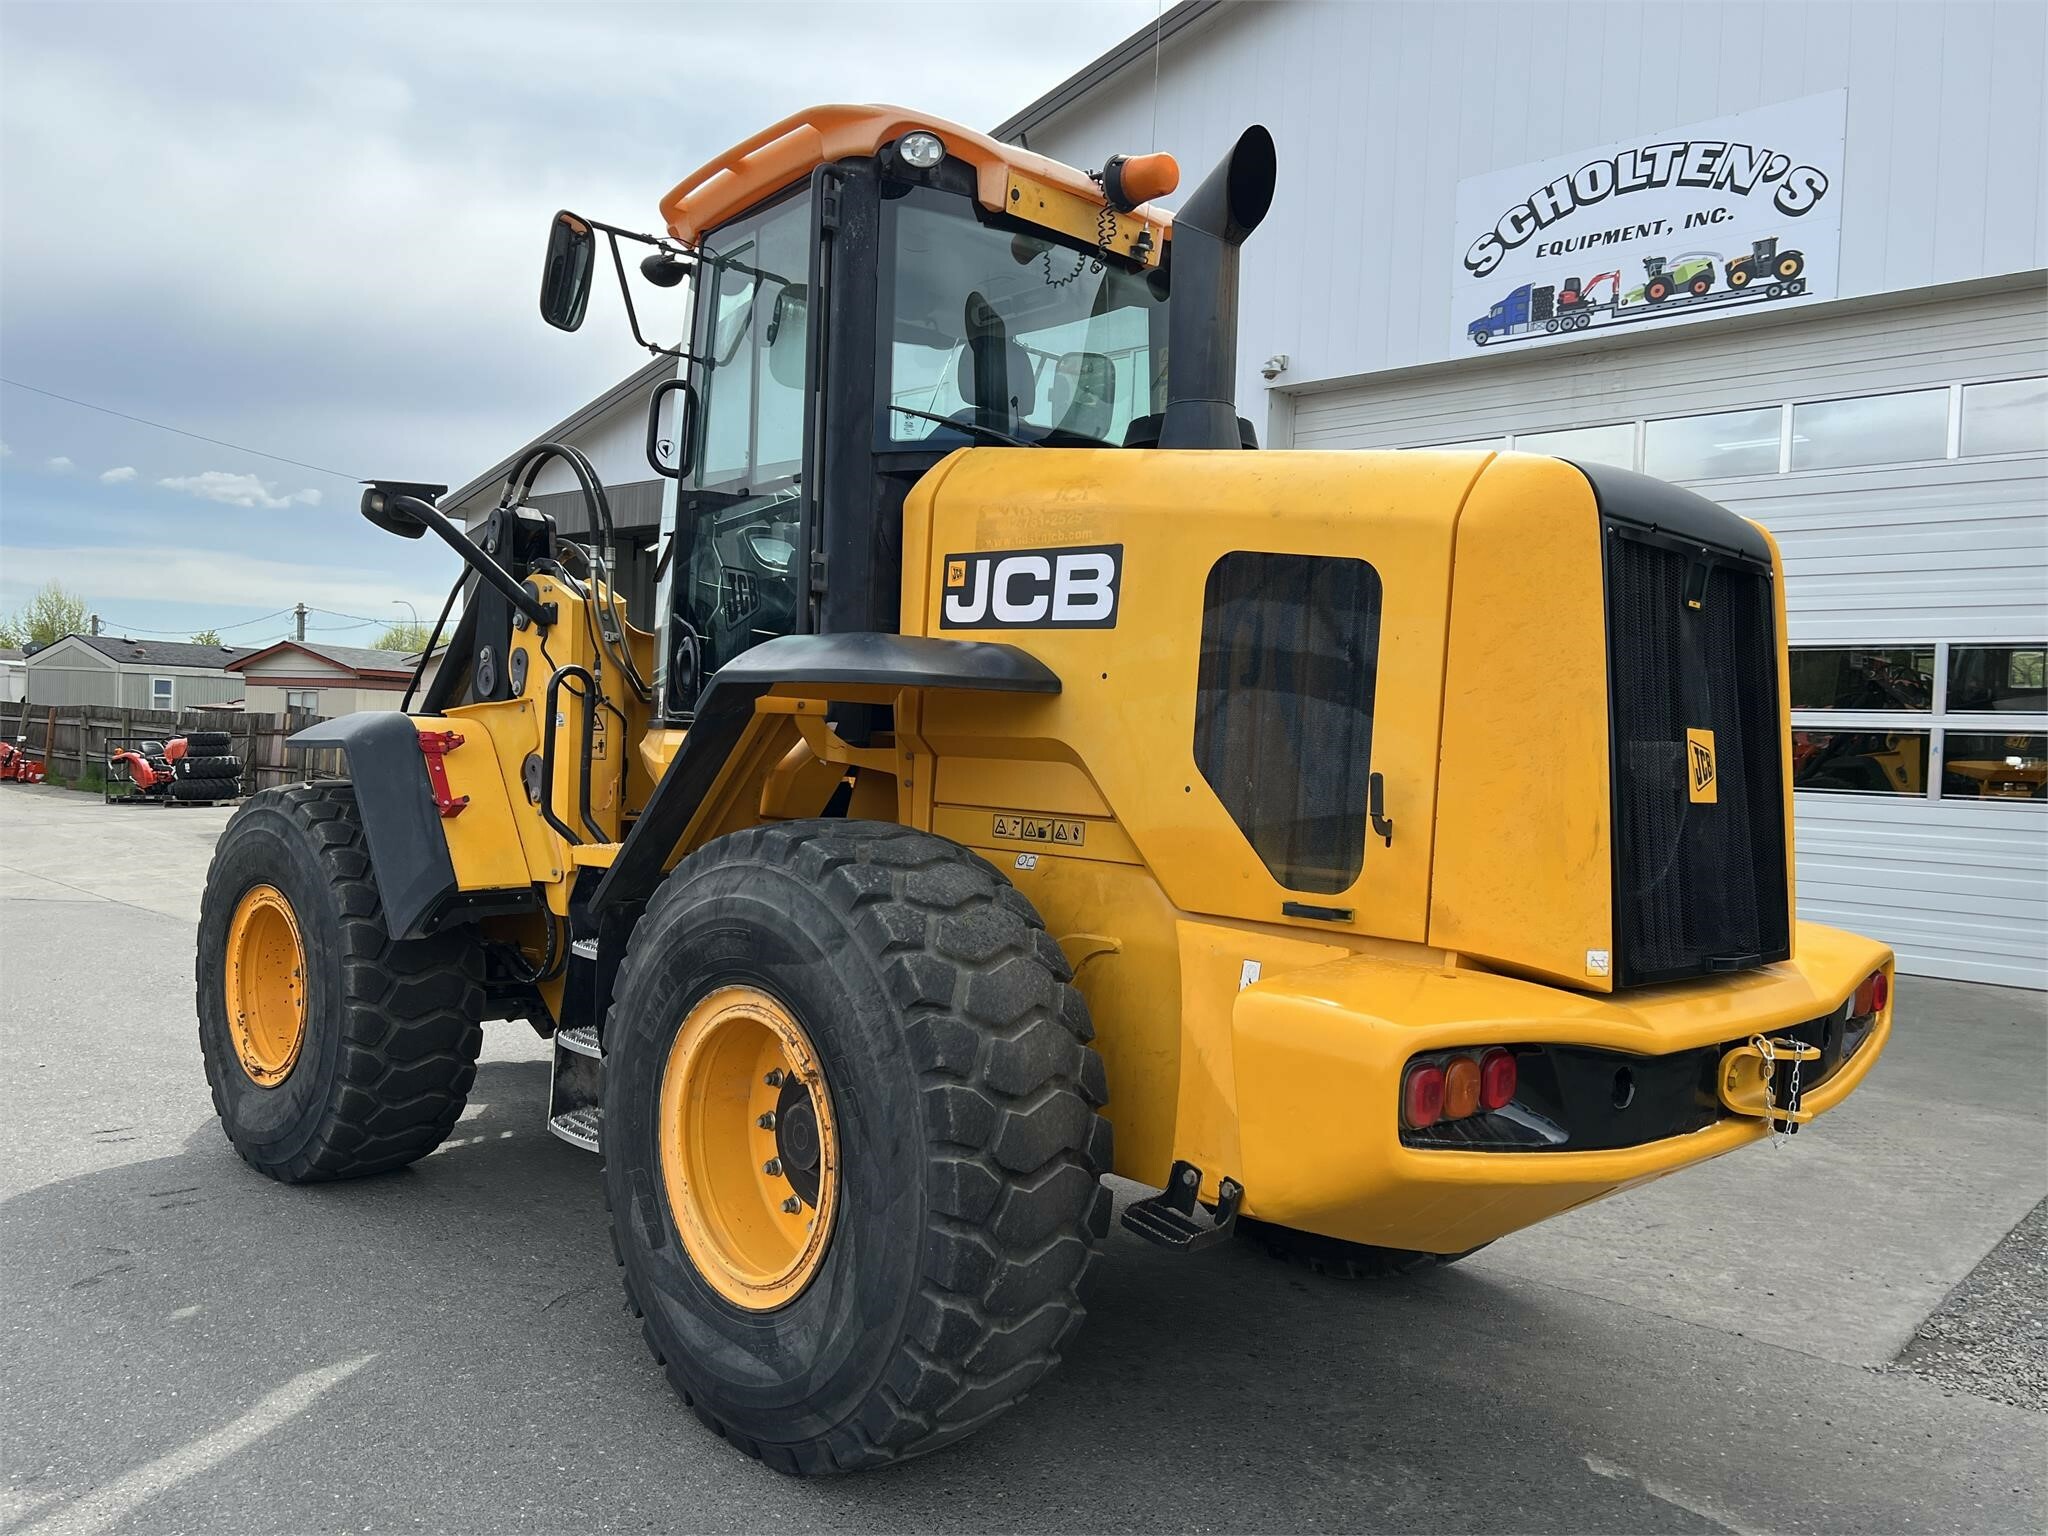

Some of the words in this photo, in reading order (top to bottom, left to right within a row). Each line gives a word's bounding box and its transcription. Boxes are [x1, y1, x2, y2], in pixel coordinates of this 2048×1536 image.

[1464, 141, 1828, 277] SCHOLTEN'S
[1535, 219, 1674, 258] EQUIPMENT,
[1683, 207, 1734, 229] INC.
[945, 553, 1115, 623] JCB
[1693, 746, 1713, 786] JCB
